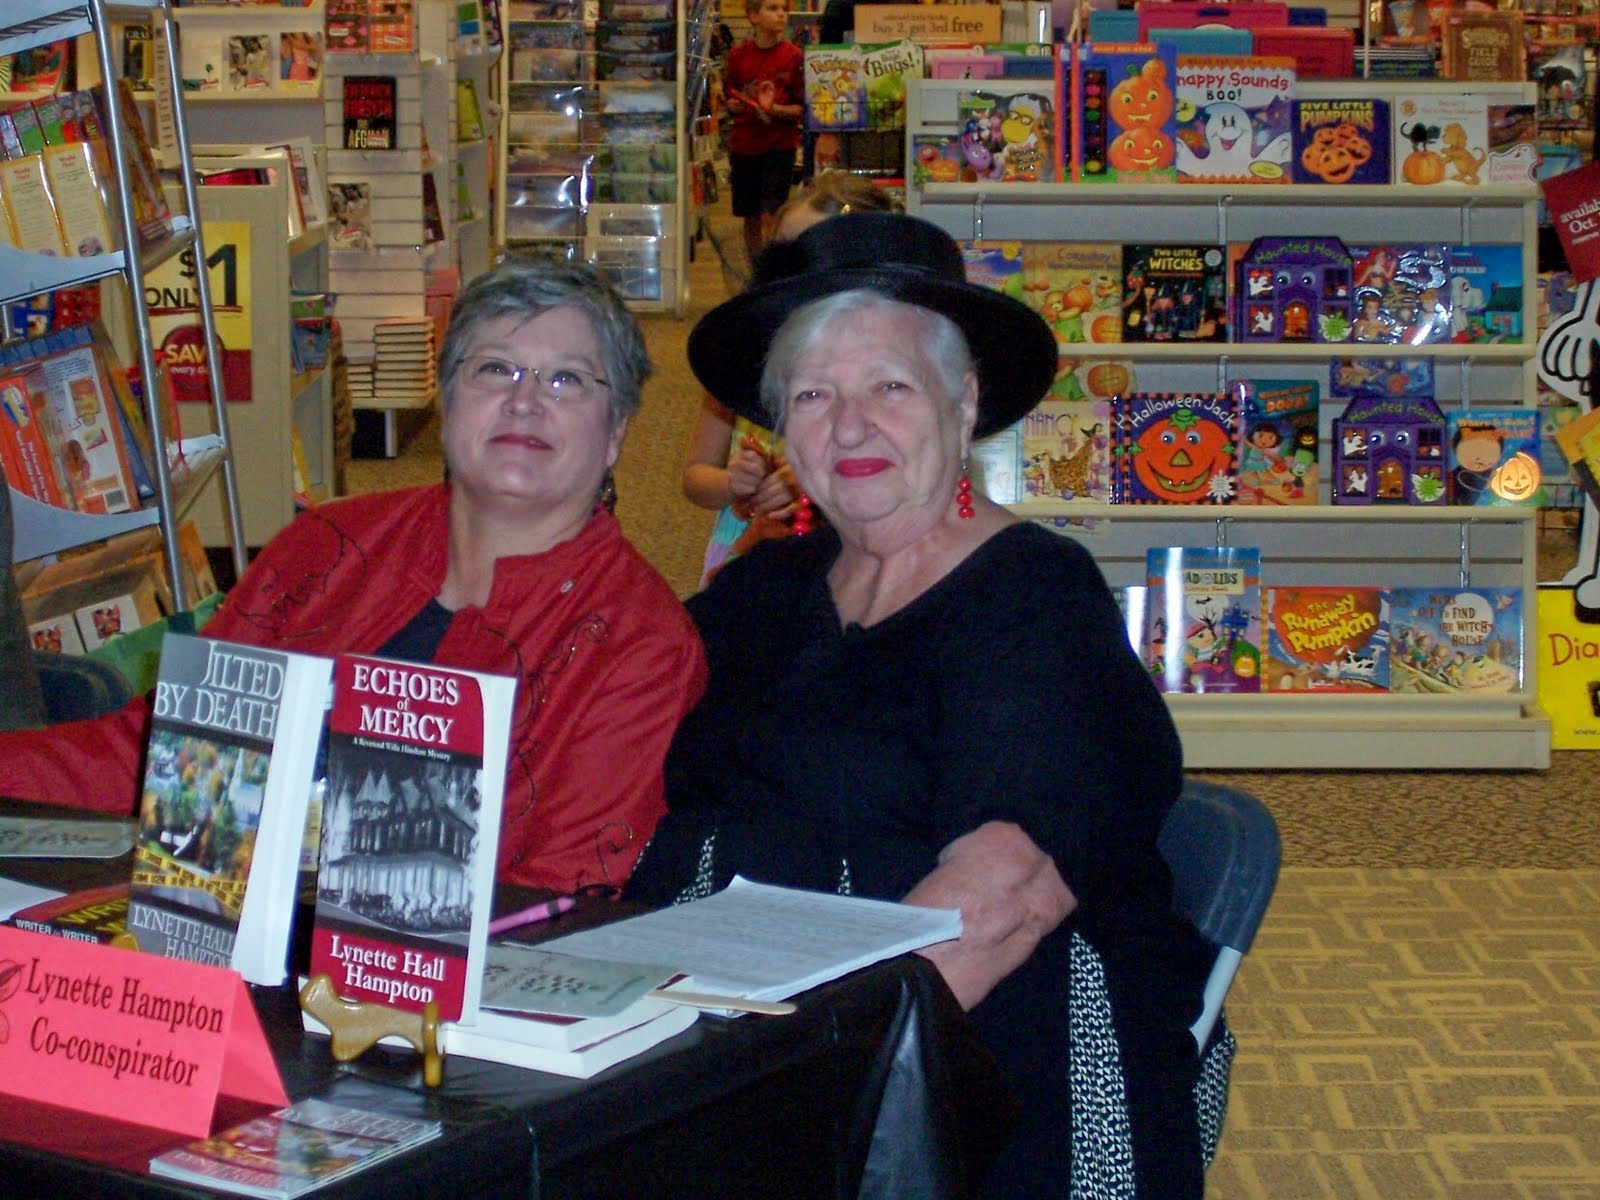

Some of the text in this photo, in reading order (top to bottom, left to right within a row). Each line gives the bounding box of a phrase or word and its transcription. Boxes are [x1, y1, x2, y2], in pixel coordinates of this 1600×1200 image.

[930, 22, 949, 33] 3rd
[952, 16, 984, 33] free
[1176, 72, 1289, 91] nappy Sounds
[1206, 88, 1242, 101] BOO!
[1149, 257, 1204, 272] WITCHES
[1153, 248, 1198, 257] TWO LITTLE
[144, 287, 199, 307] ONL
[164, 343, 206, 364] SAV
[1128, 397, 1202, 427] Halloween
[1204, 398, 1236, 429] Jack
[1281, 594, 1355, 631] Runaway
[1307, 601, 1328, 613] The
[1452, 607, 1475, 619] FIND
[1287, 612, 1376, 653] Pumpkin
[1451, 634, 1484, 647] HOUSE
[200, 641, 284, 700] JILTED
[352, 664, 459, 706] ECHOES
[153, 681, 279, 739] BY DEATH
[397, 697, 410, 711] of
[359, 705, 454, 745] MERCY
[352, 736, 358, 745] A
[15, 919, 52, 935] WRITER
[62, 929, 98, 945] WRITER
[132, 904, 200, 944] LYNETTE
[330, 935, 445, 981] Lynette Hall
[25, 958, 224, 1033] Lynette Hampton
[344, 962, 433, 1004] Hampton
[30, 1016, 199, 1086] Co-conspirator
